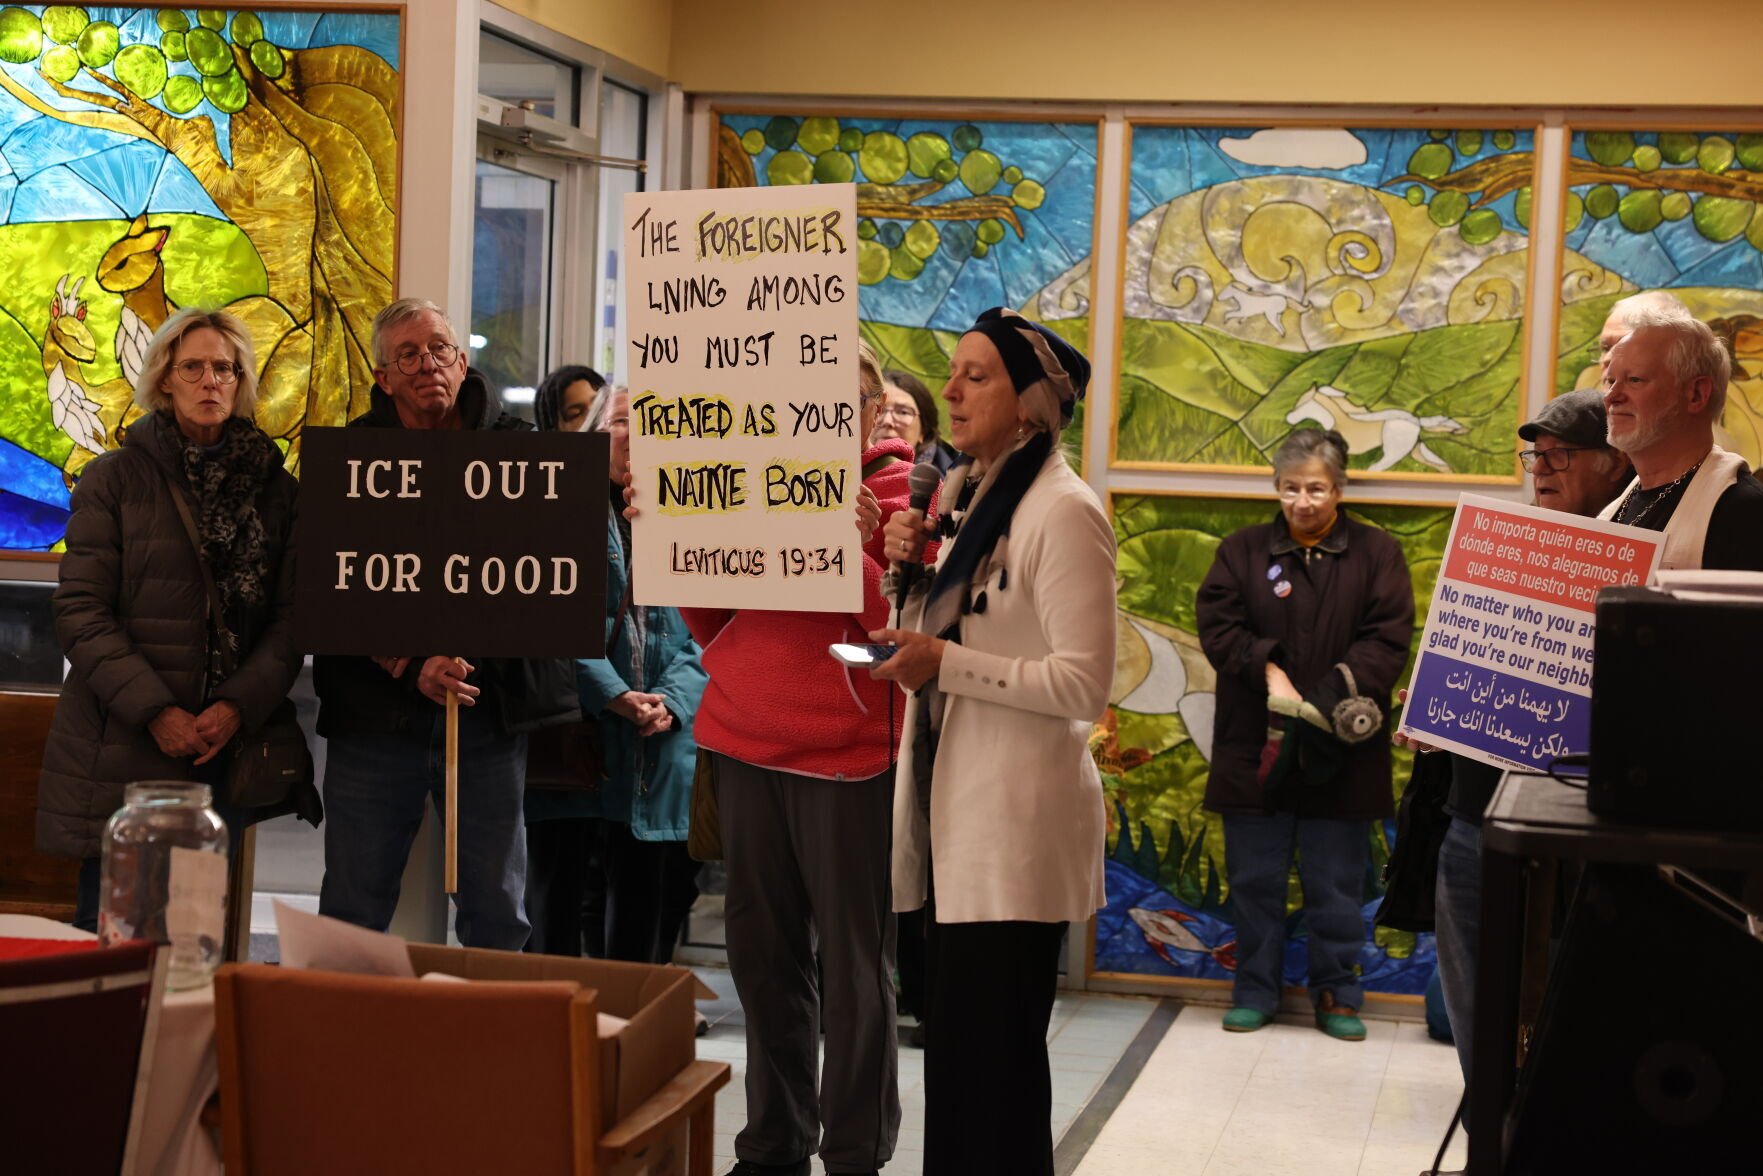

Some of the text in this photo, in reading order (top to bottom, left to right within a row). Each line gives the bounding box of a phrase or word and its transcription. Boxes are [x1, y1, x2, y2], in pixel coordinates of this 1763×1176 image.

[632, 207, 847, 257] THE FOREIGNER
[747, 273, 845, 311] AMONG
[632, 331, 837, 369] YOU MUST BE
[633, 395, 854, 439] TREATED AS YOUR
[346, 459, 565, 500] ICE OUT
[765, 465, 846, 507] BORN
[1473, 512, 1636, 562] No importa quién eres o de
[334, 551, 578, 596] FOR GOOD
[672, 542, 844, 577] LEVITICUS 19:34
[1459, 533, 1639, 586] dónde eres, nos alegramos de
[1467, 560, 1488, 579] que
[1490, 566, 1518, 585] seas
[1519, 572, 1566, 596] nuestro
[1440, 585, 1596, 638] No matter who you ar
[1429, 629, 1460, 650] glad
[1508, 653, 1535, 671] our
[1438, 609, 1480, 632] where
[1531, 631, 1567, 656] from
[1571, 645, 1594, 663] we
[1427, 696, 1457, 729] جارنا
[1445, 671, 1570, 724] لا يهمنا من أين انت
[1459, 709, 1485, 732] انك
[1485, 714, 1532, 755] يسعدنا
